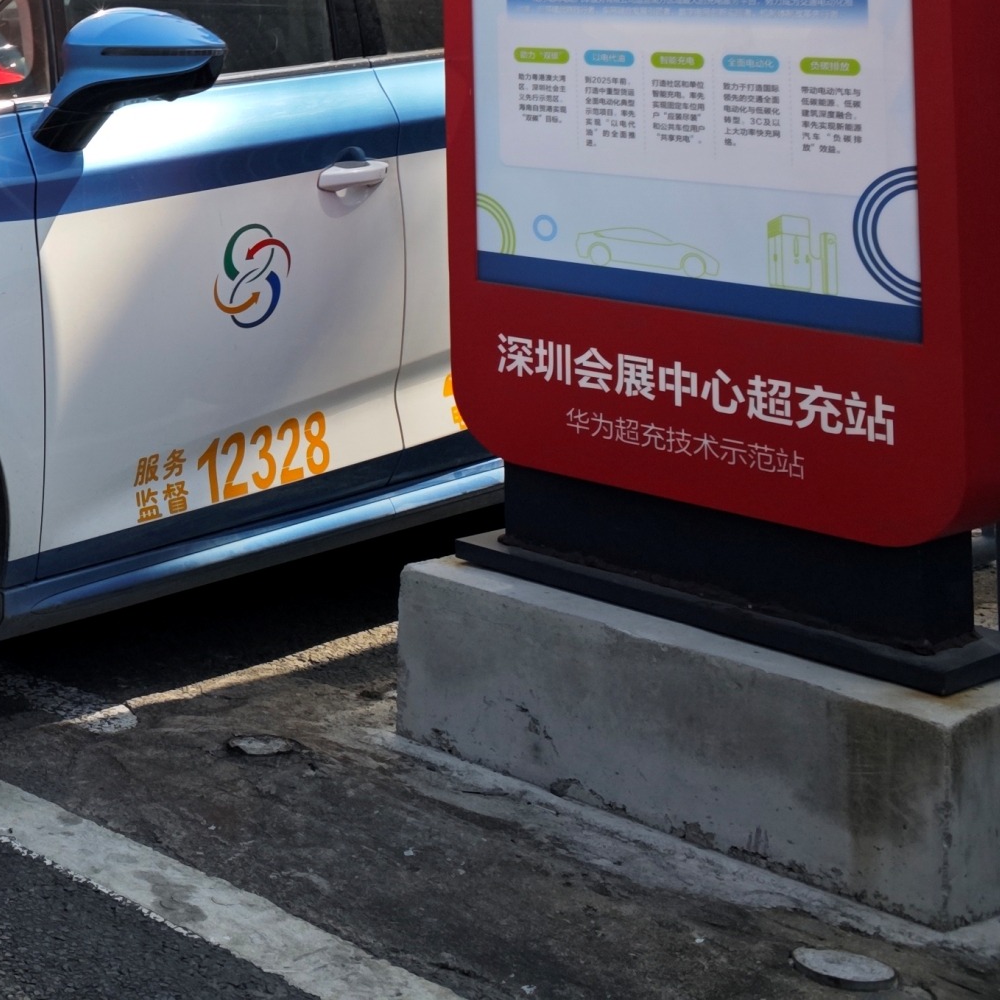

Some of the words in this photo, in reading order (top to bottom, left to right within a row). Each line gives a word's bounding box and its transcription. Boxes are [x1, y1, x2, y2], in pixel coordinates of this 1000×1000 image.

[497, 333, 895, 446] 深圳会展中心超充站
[134, 448, 187, 487] 服务
[197, 411, 330, 504] 12328
[566, 407, 805, 480] 华为超充技术示范站
[136, 480, 189, 523] 监督
